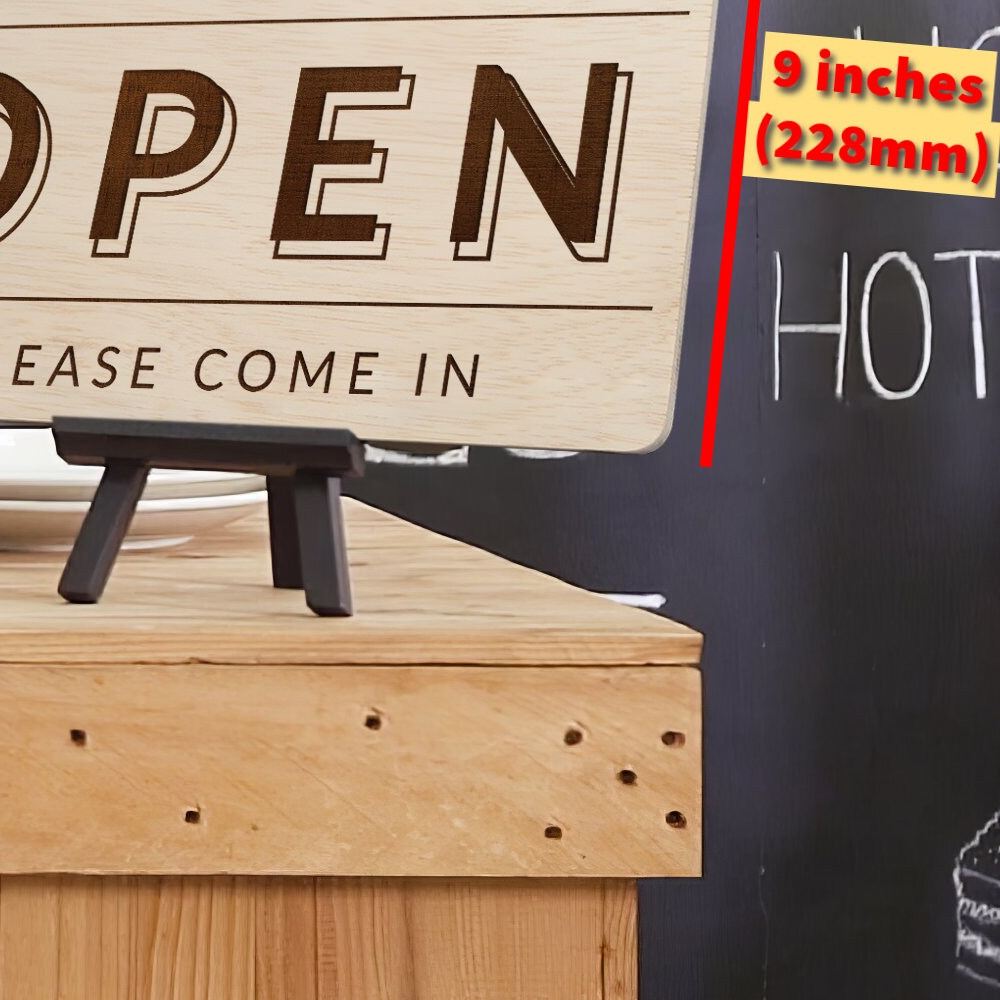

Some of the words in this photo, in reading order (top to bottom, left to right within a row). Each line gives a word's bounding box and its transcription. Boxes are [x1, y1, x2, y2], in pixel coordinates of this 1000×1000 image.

[194, 347, 379, 395] COME
[414, 352, 480, 398] IN
[774, 250, 1000, 401] HOT
